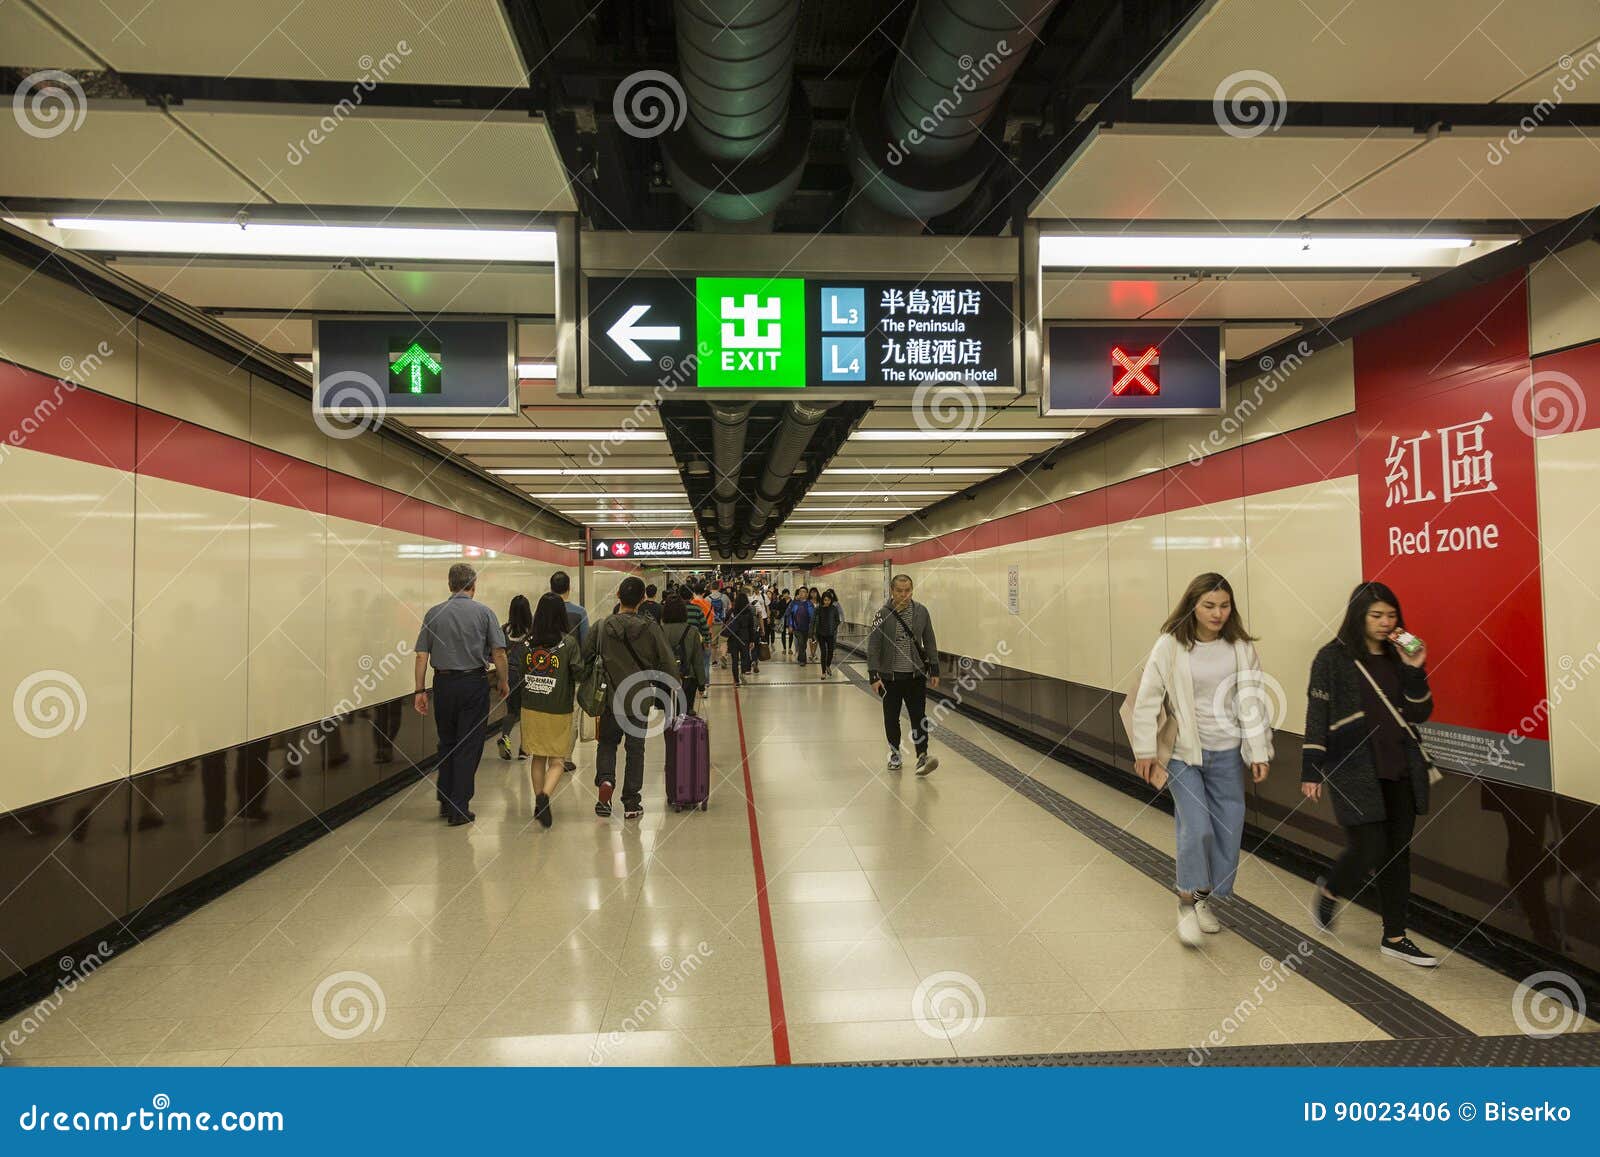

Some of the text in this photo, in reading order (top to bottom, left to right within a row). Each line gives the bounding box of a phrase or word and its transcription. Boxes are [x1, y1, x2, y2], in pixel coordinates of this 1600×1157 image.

[880, 288, 981, 315] 半島酒店
[881, 319, 965, 332] The Peninsula
[721, 351, 781, 371] EXIT
[880, 338, 982, 364] 九龍酒店
[881, 367, 997, 381] The Kowloon Hotel
[1385, 411, 1498, 508] 紅區
[1389, 521, 1499, 556] Red zone
